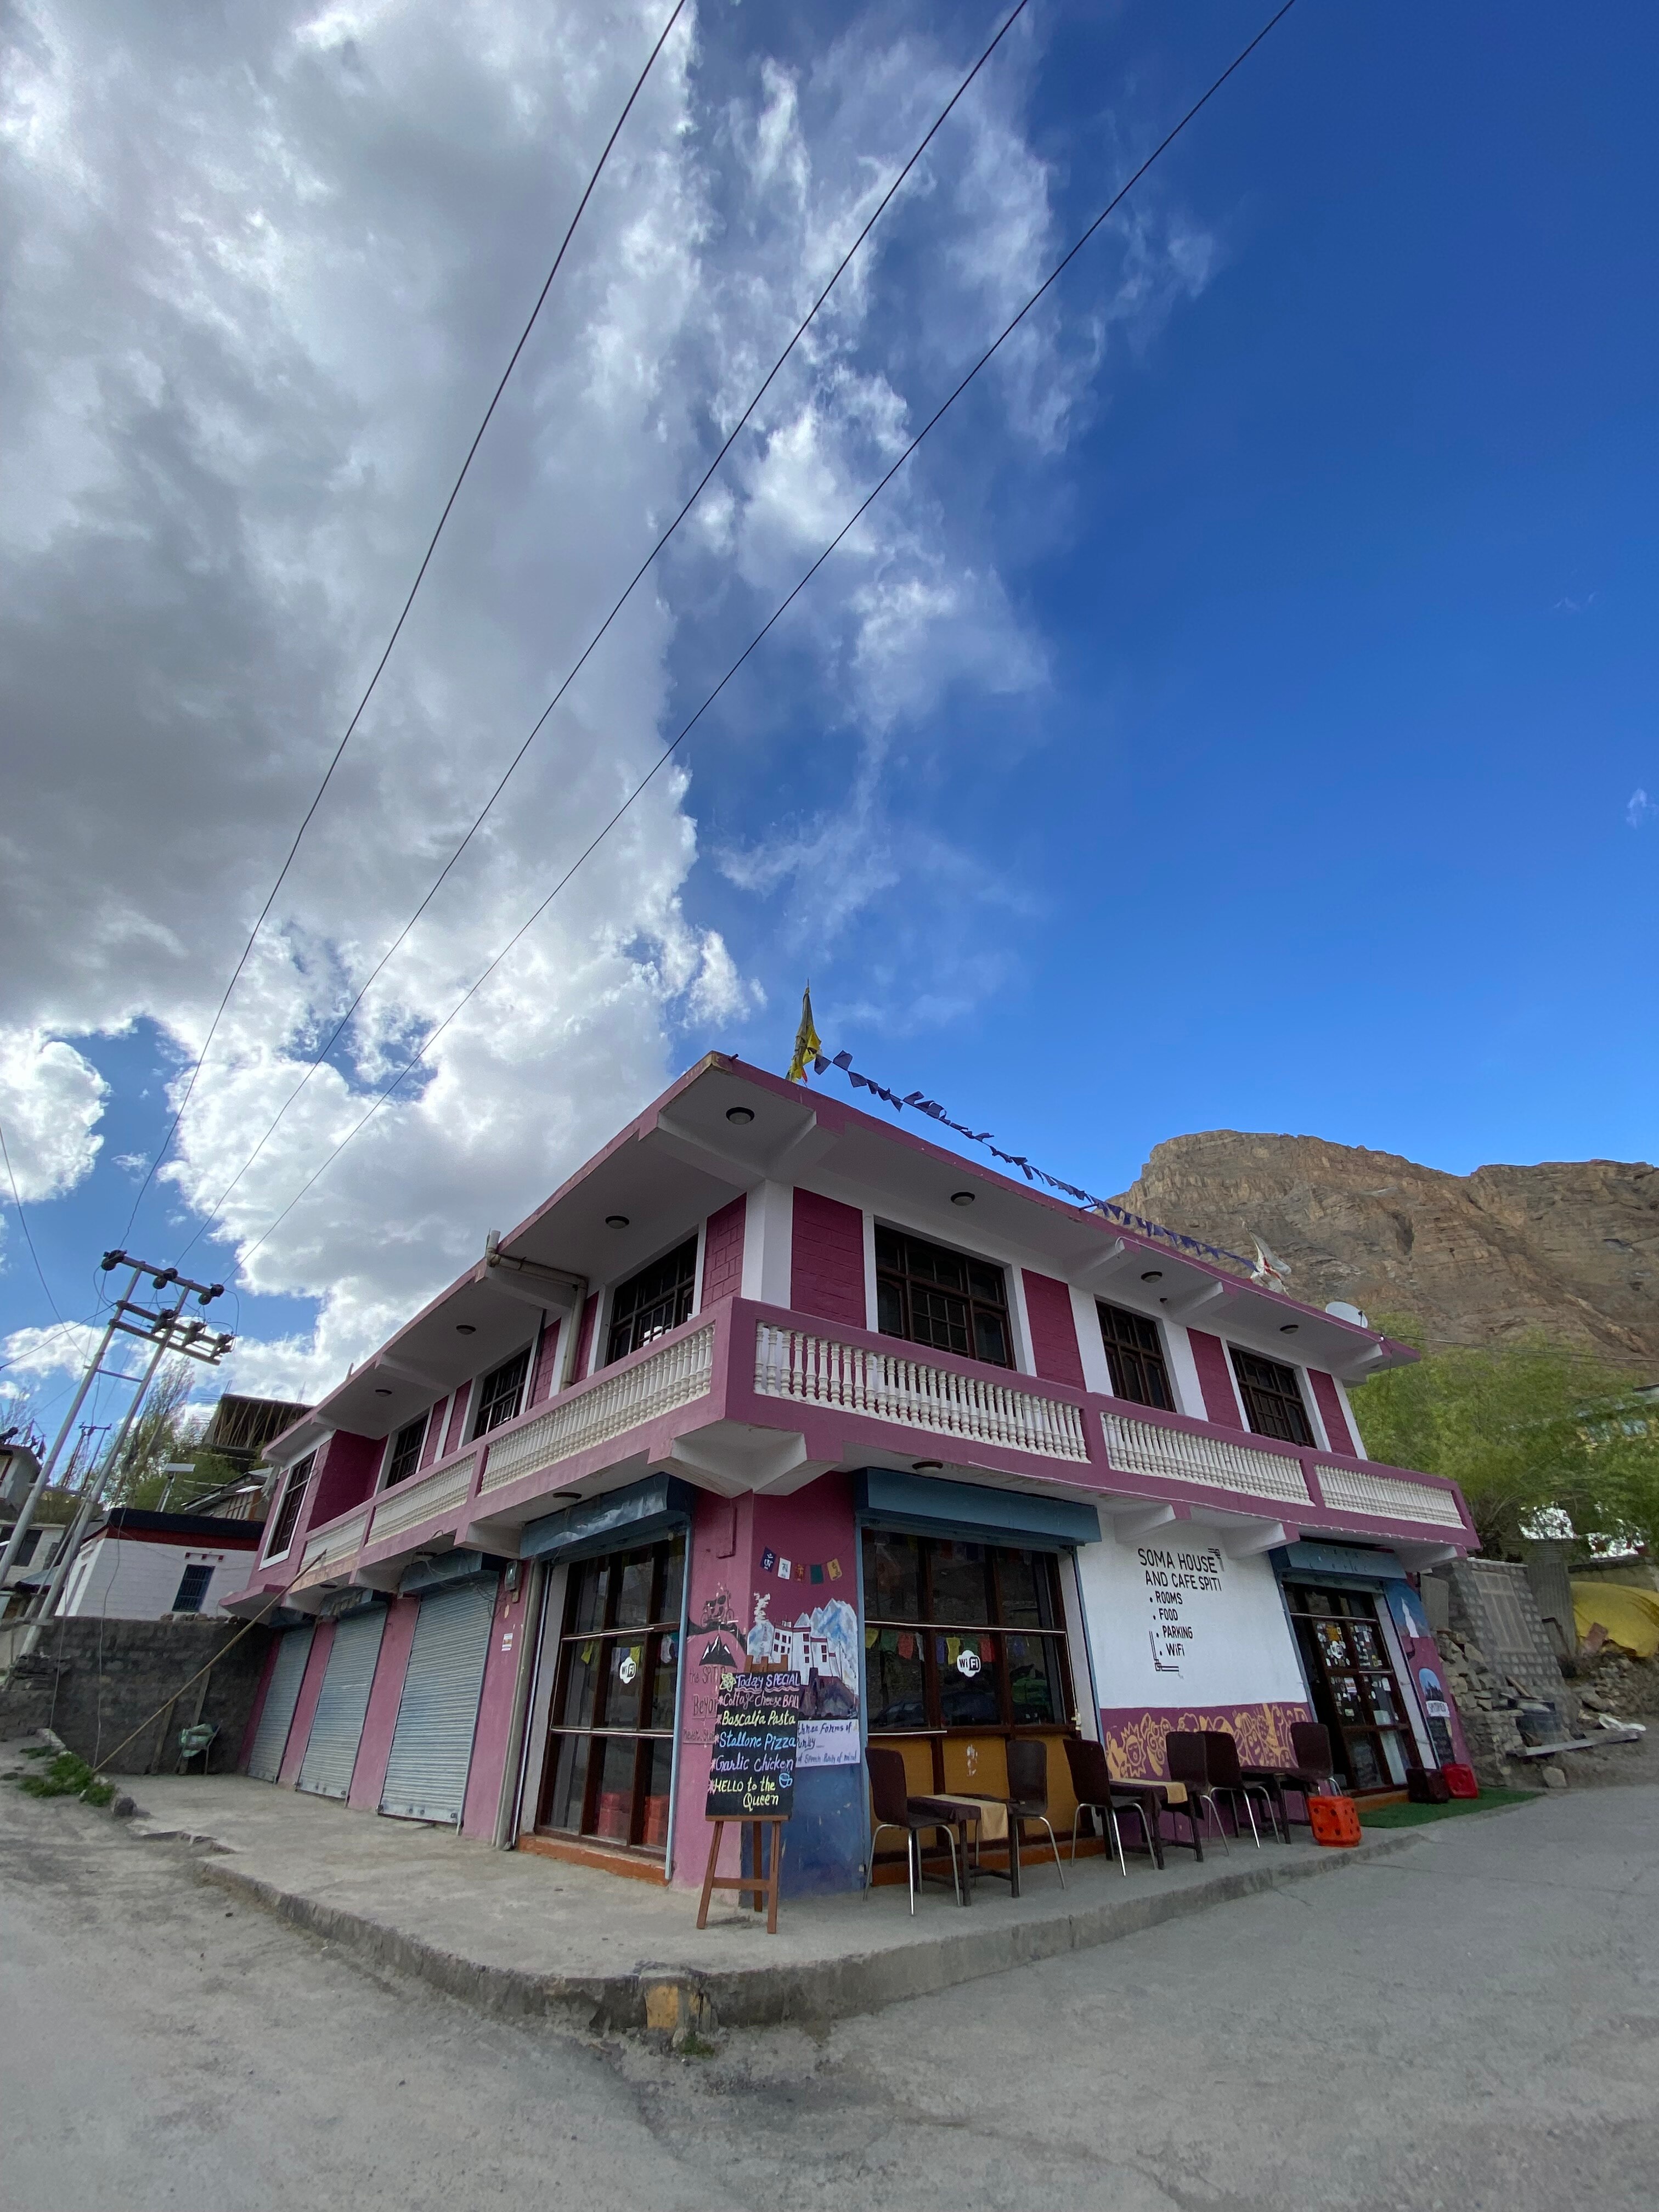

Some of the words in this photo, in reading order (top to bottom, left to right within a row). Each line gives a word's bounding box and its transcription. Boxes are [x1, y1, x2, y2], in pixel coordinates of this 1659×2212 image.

[1138, 1548, 1175, 1569] SOMA
[1177, 1553, 1217, 1573] HOUSE
[1146, 1570, 1168, 1587] AND
[1171, 1573, 1198, 1589] CAFE
[1199, 1576, 1222, 1591] SPITI
[1155, 1591, 1183, 1605] ROOMS
[1159, 1608, 1178, 1621] FOOD
[1162, 1625, 1193, 1639] PARKING
[736, 1673, 764, 1689] Today
[766, 1673, 800, 1687] SPECIAL
[724, 1691, 754, 1709] Cottage
[768, 1709, 796, 1725] Pasta
[719, 1730, 761, 1748] Stallone
[764, 1733, 796, 1751] Pizza
[716, 1752, 749, 1772] Garlic
[714, 1778, 743, 1792] HELLO
[747, 1776, 757, 1792] to
[760, 1775, 776, 1792] the
[743, 1793, 779, 1812] Queen
